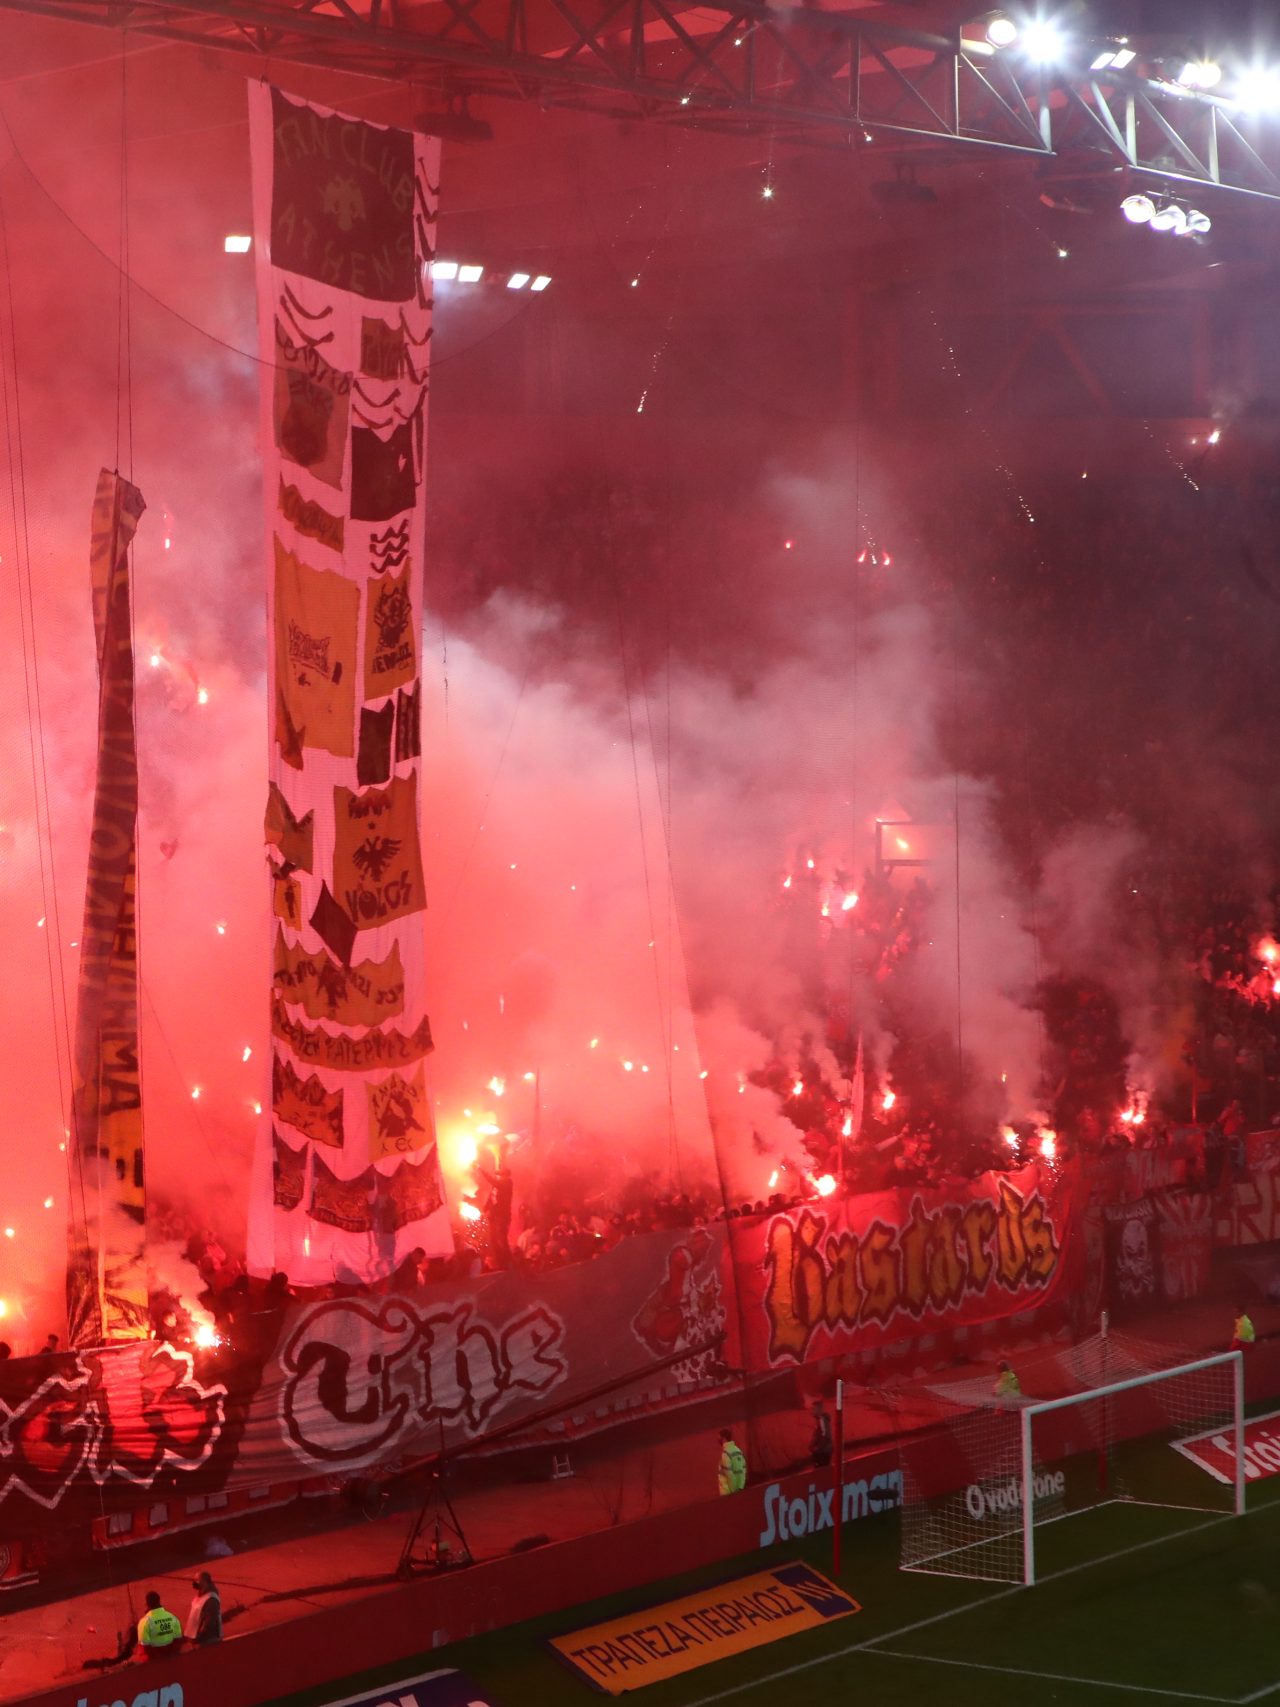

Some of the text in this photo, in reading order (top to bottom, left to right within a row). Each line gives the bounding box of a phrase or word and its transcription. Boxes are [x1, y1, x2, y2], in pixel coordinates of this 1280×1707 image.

[279, 1295, 568, 1472] The
[764, 1174, 1061, 1367] Bastards
[760, 1469, 904, 1547] Stoixman
[984, 1470, 1065, 1513] vodone
[571, 1586, 806, 1678] ΤΡΑΠΕΖΑ ΠΕΙΡΑΙΩΣ
